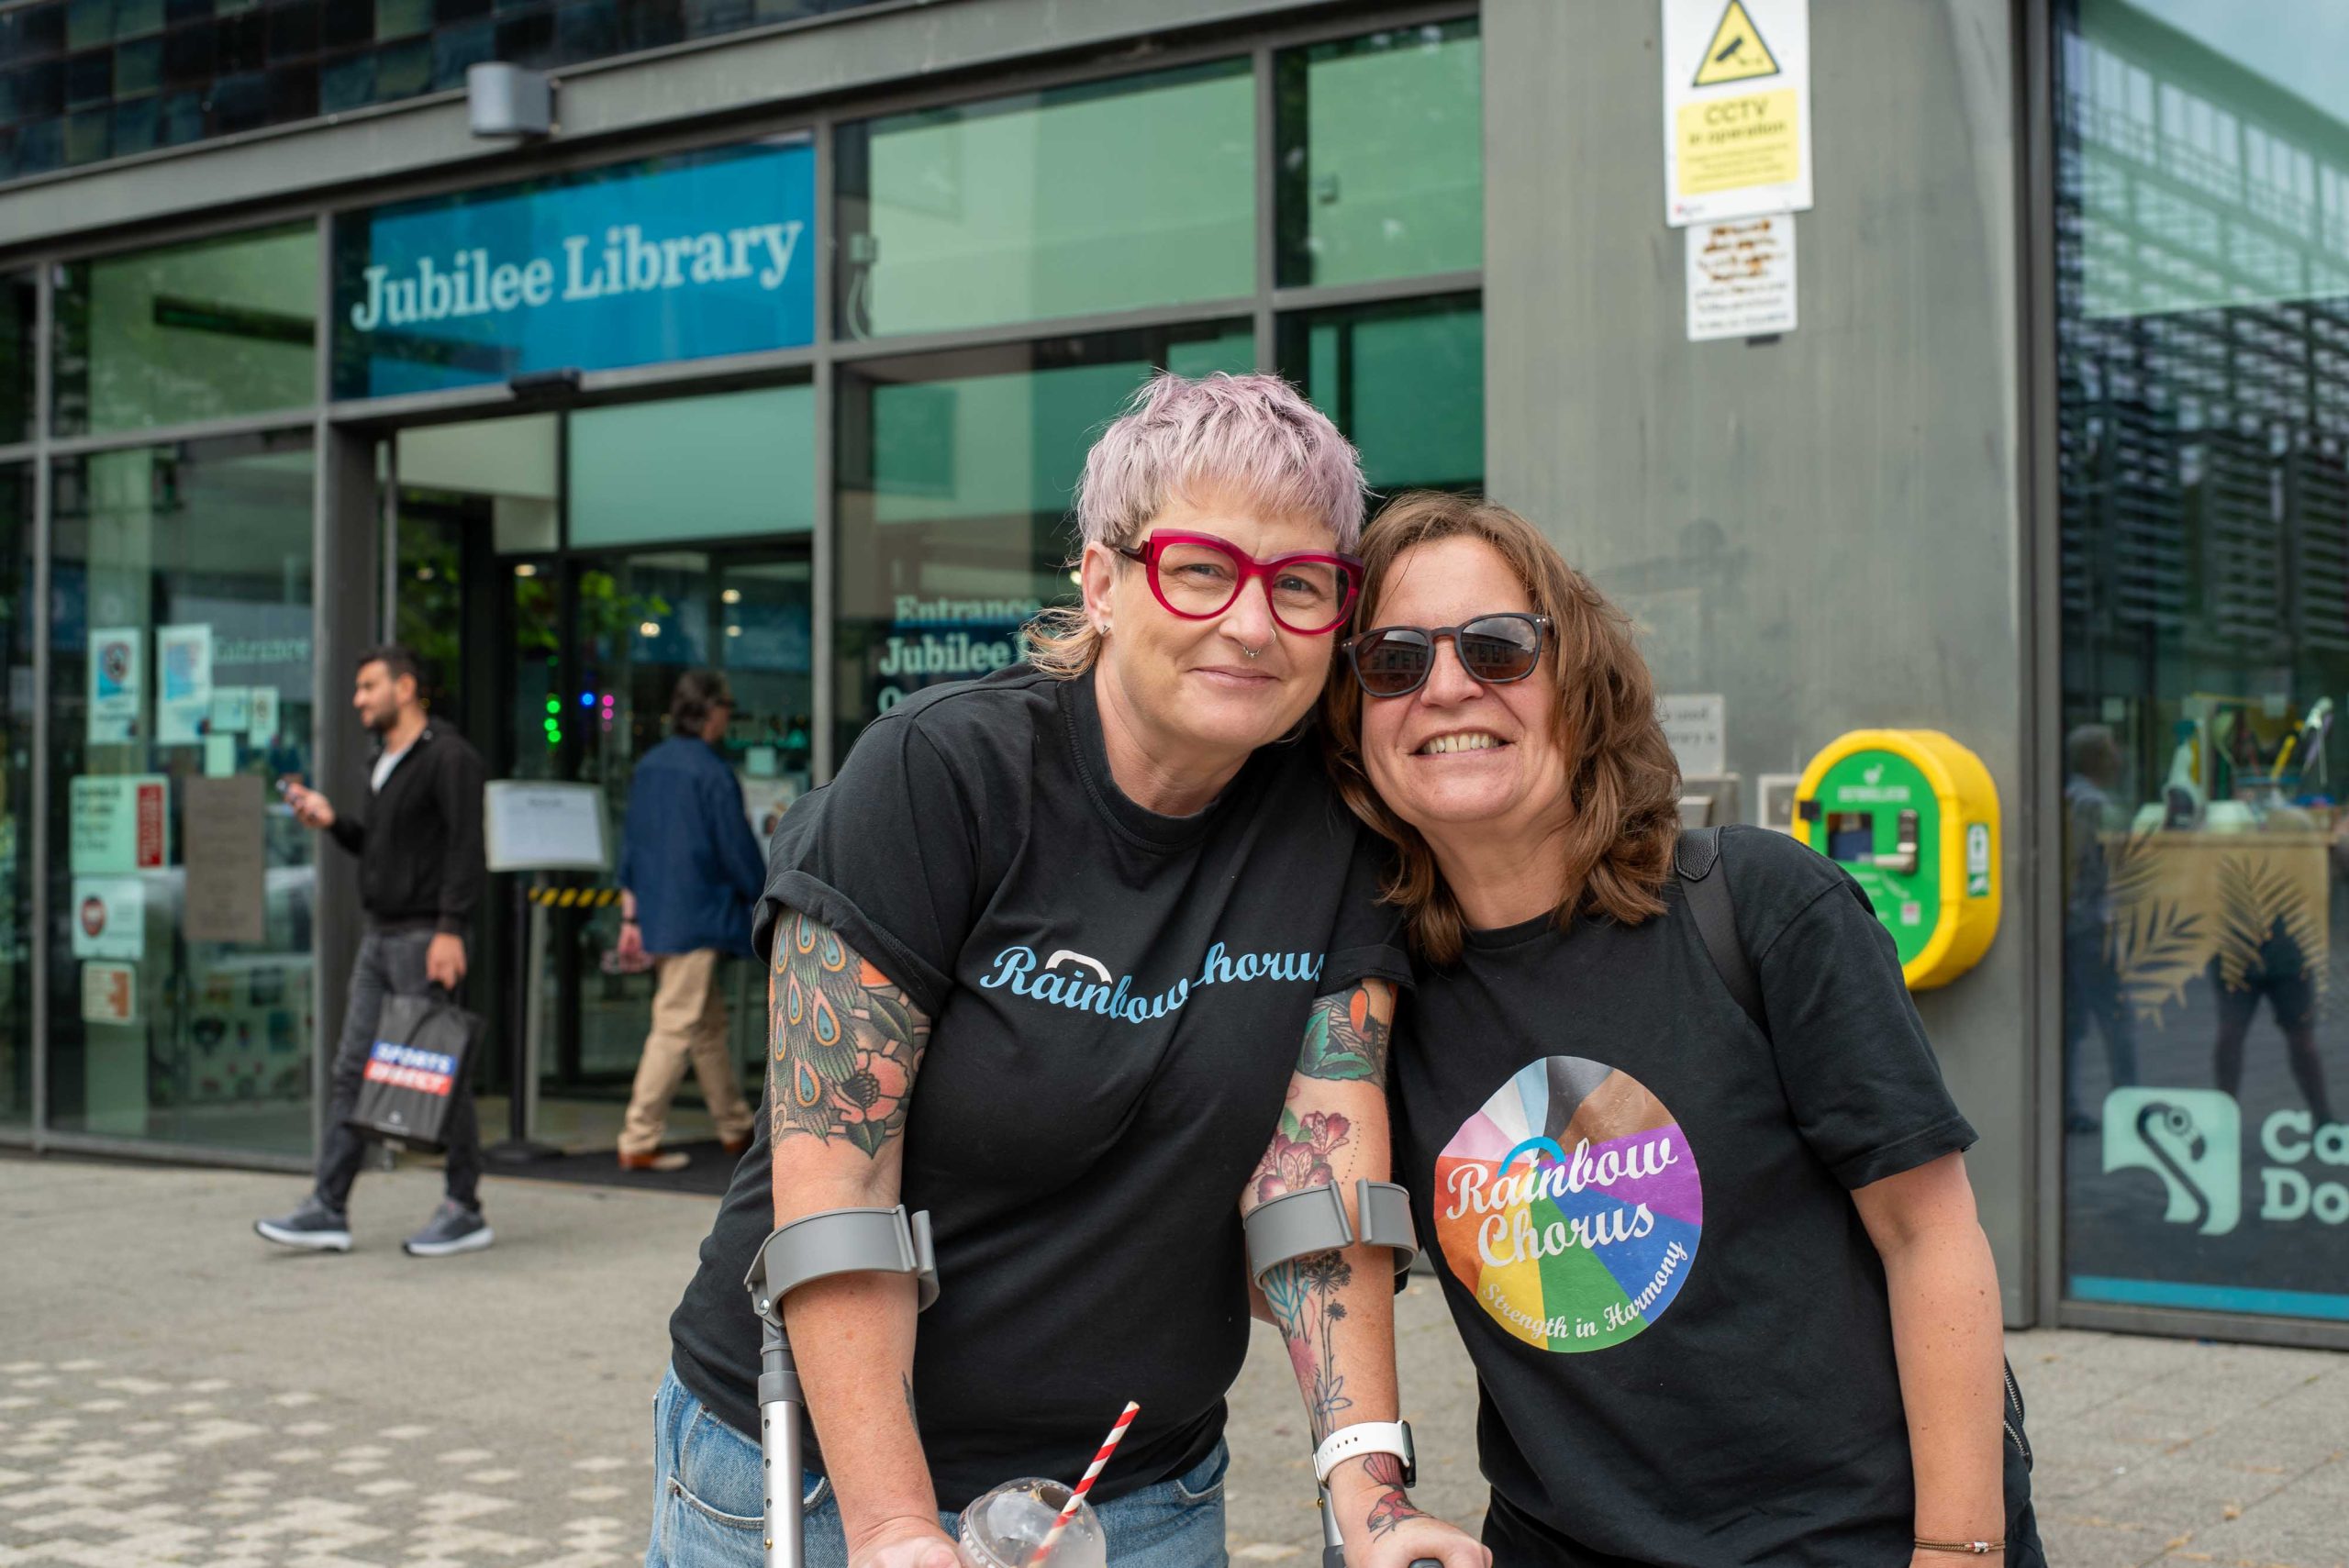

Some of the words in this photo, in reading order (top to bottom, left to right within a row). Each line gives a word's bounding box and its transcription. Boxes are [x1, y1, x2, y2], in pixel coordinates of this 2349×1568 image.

[1705, 97, 1769, 126] CCTV
[1709, 120, 1787, 145] operation
[351, 248, 554, 331] Jubilee
[562, 220, 804, 301] Library
[878, 632, 1012, 676] Jubilee
[980, 946, 1189, 1024] Rainbow
[1446, 1138, 1678, 1219] Rainbow
[2261, 1166, 2349, 1225] Do
[1477, 1203, 1654, 1268] Chorus
[1482, 1284, 1568, 1340] Strength
[1575, 1318, 1598, 1338] in
[1603, 1240, 1687, 1332] Harmony
